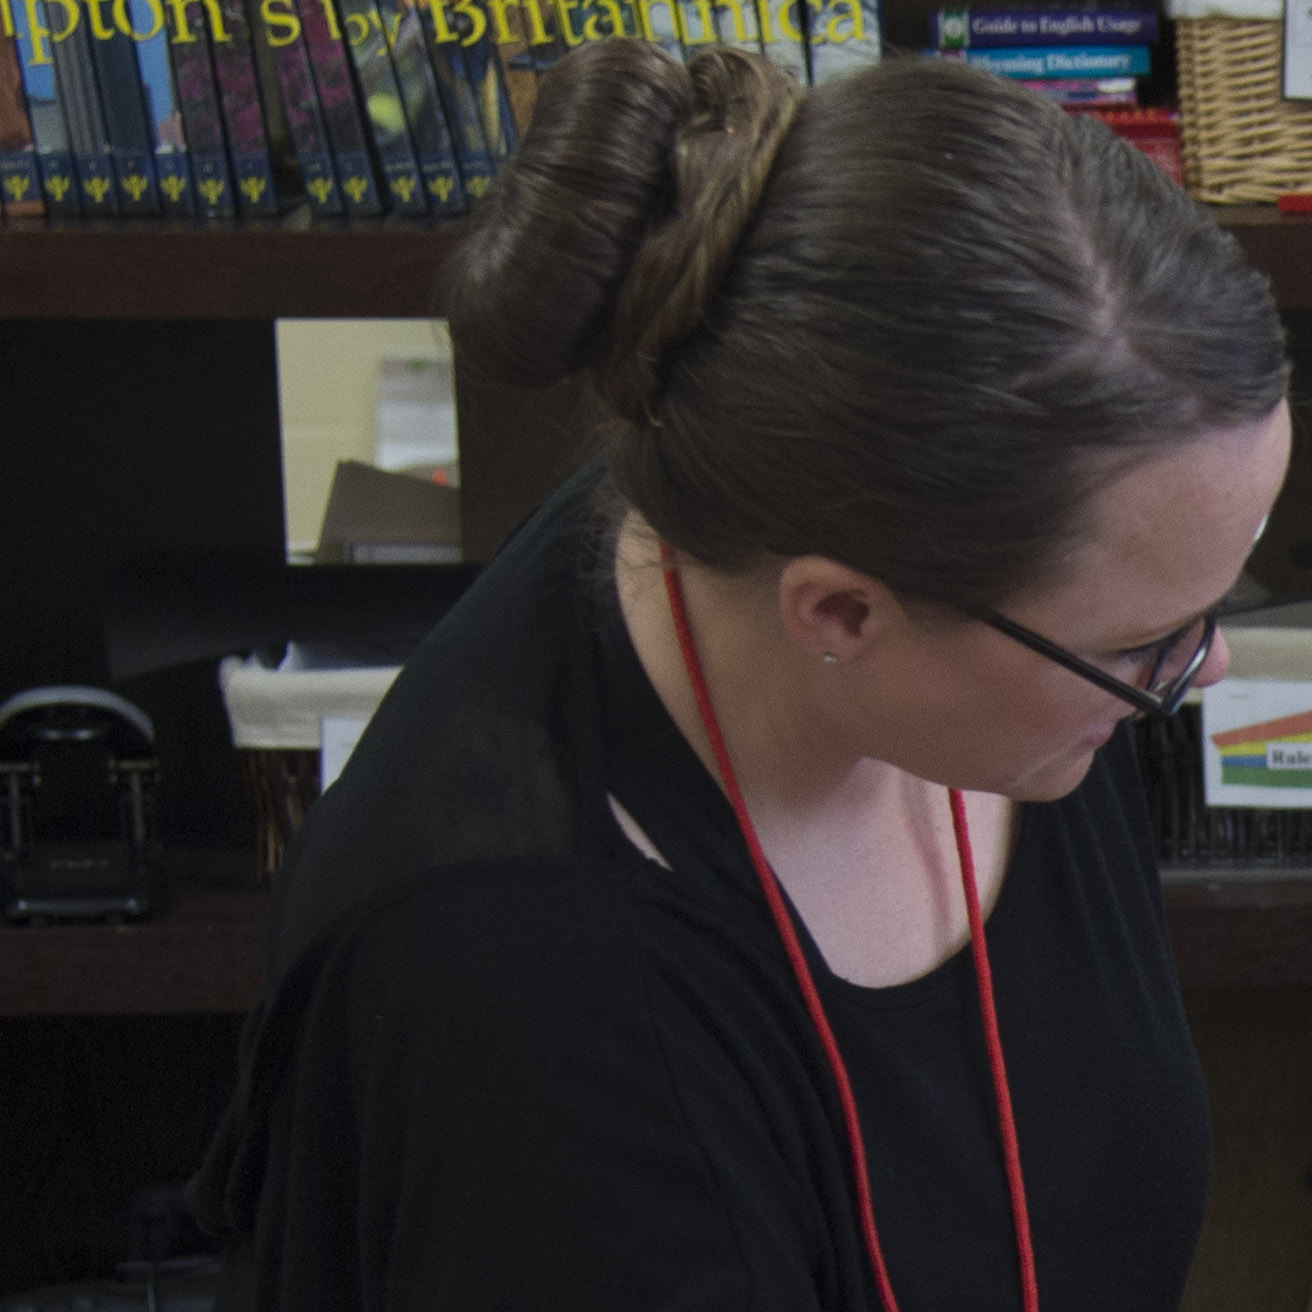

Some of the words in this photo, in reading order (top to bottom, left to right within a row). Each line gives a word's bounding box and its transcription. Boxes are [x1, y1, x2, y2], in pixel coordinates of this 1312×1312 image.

[432, 0, 867, 47] Britannica
[971, 17, 1017, 36] Guide
[1040, 15, 1095, 36] English
[1098, 16, 1143, 36] Usage
[1046, 54, 1132, 72] Dictionary
